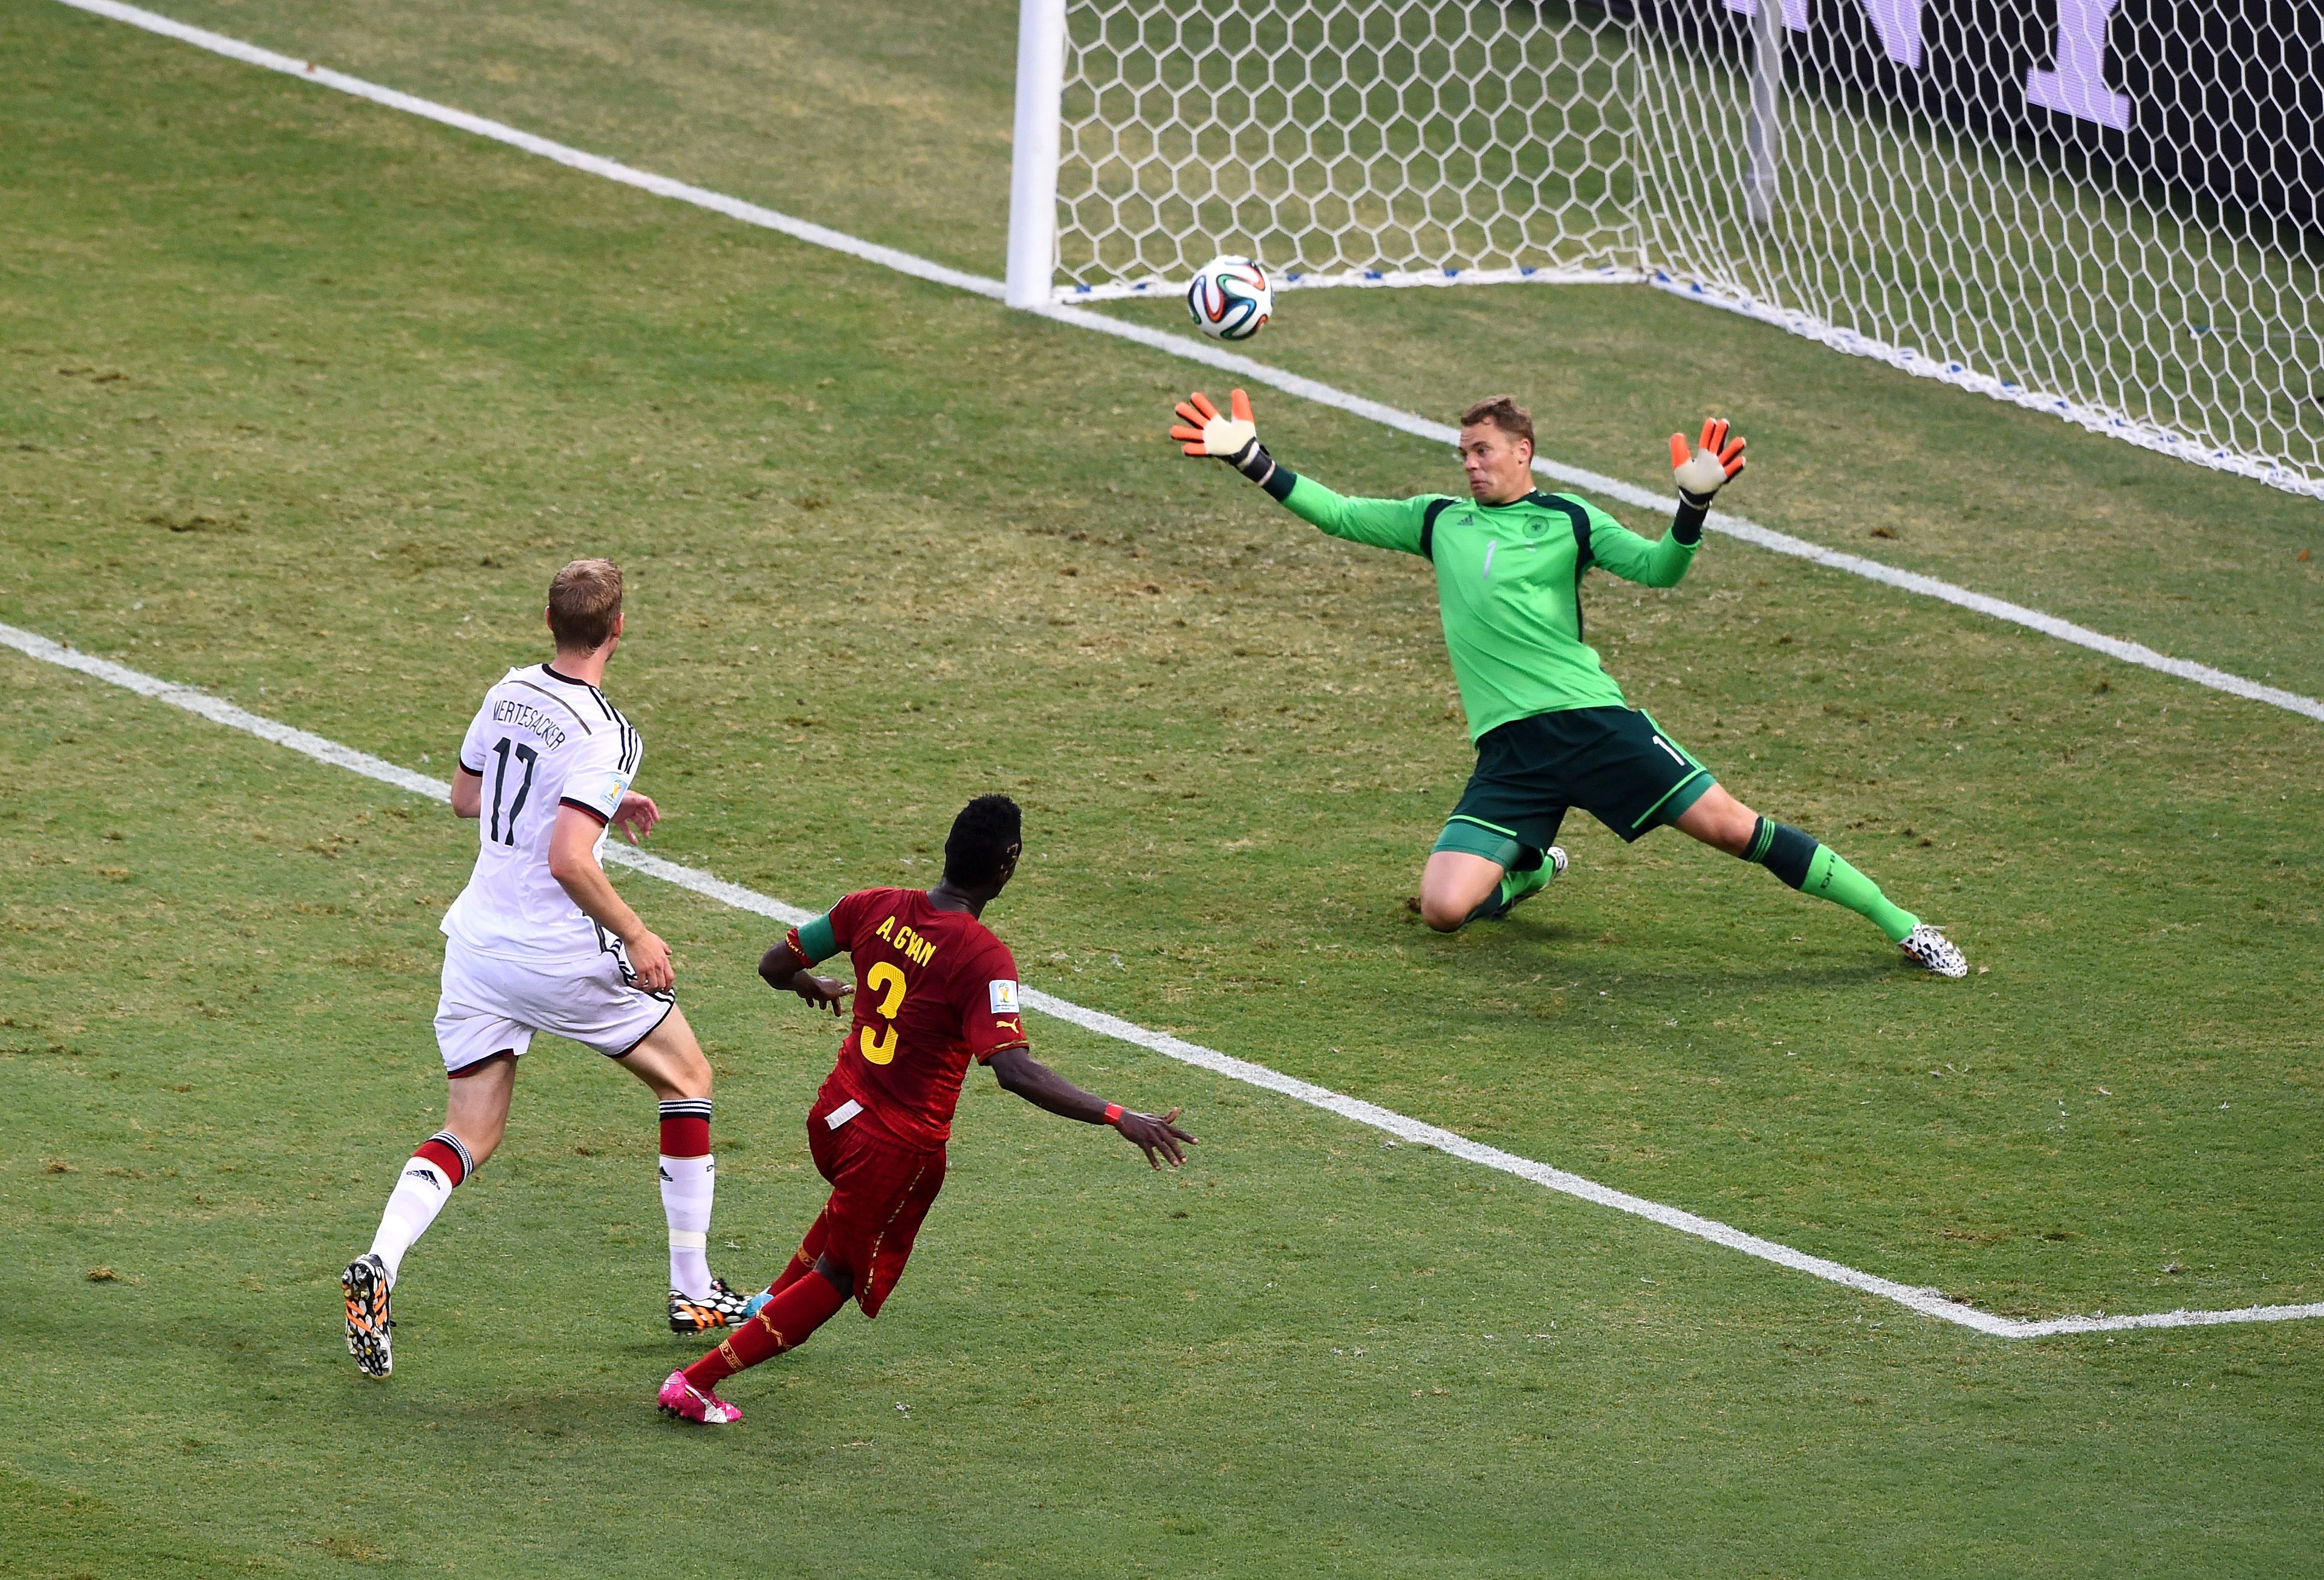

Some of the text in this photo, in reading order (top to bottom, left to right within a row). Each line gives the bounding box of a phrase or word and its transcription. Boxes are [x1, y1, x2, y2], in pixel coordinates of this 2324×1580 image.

[1482, 540, 1497, 581] 1
[1652, 735, 1686, 766] 1
[491, 736, 539, 847] 17
[860, 961, 907, 1066] 3
